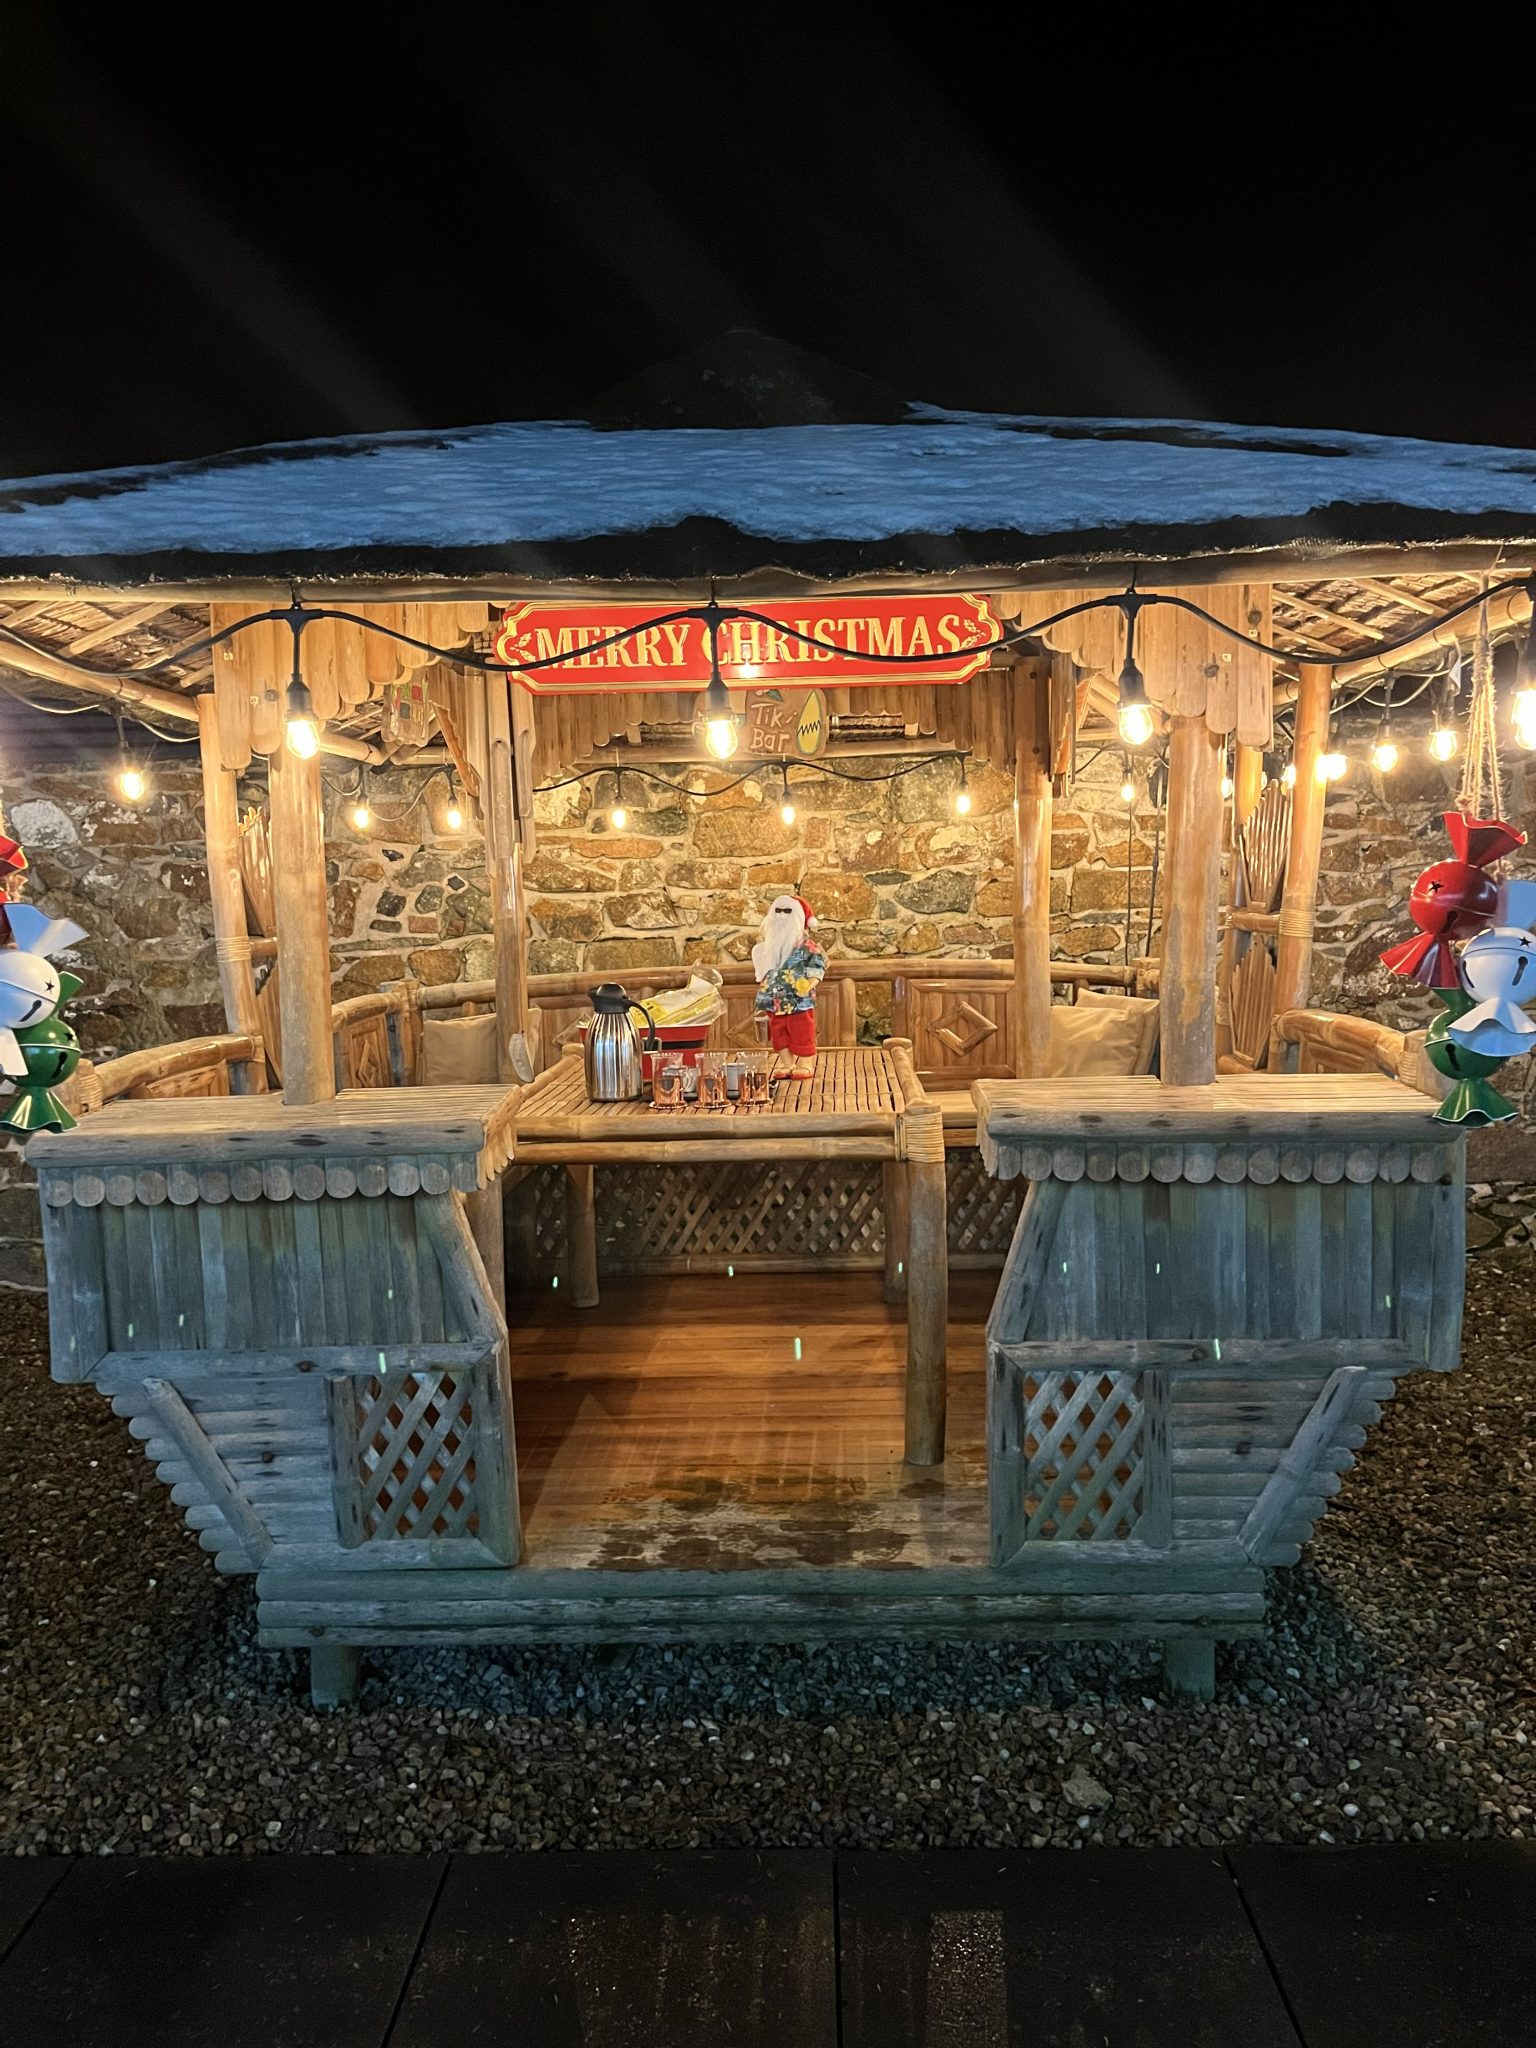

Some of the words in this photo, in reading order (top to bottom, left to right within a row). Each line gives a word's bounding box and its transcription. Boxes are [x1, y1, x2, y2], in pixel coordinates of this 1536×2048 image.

[534, 623, 691, 669] MERRY
[701, 614, 961, 666] CHRISTMAS
[751, 703, 798, 728] Tiki
[751, 728, 791, 752] Bar
